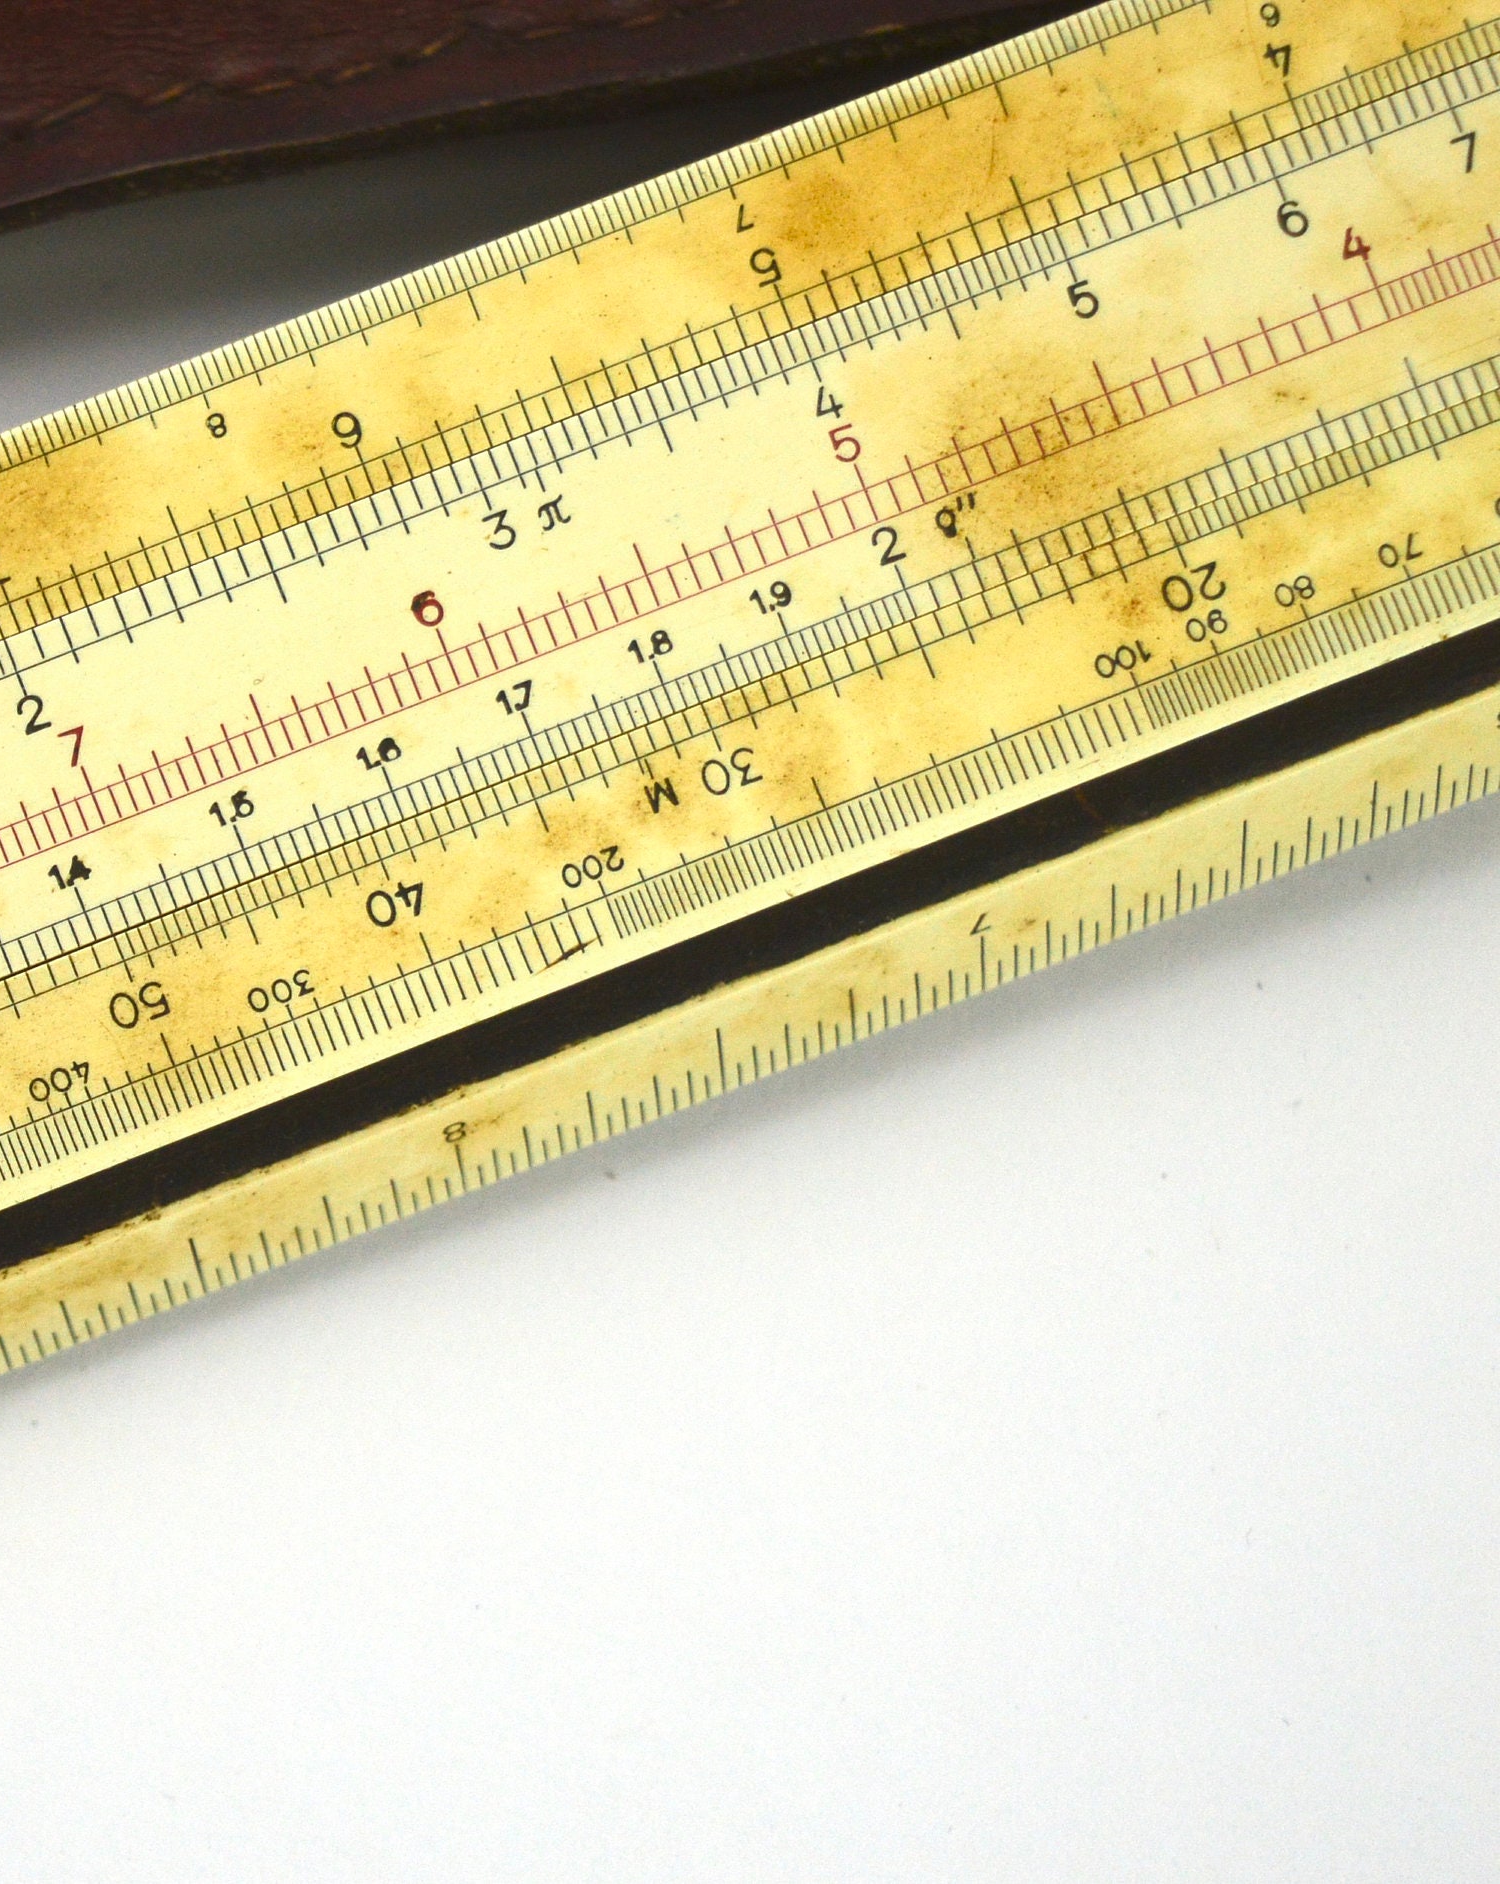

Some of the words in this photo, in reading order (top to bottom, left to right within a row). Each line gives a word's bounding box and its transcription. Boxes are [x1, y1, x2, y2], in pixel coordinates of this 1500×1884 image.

[1264, 42, 1292, 78] 4
[1450, 132, 1477, 173] 7
[735, 205, 756, 234] 7
[1276, 201, 1309, 237] 6
[1342, 227, 1371, 261] 4
[749, 247, 782, 286] 5
[1067, 281, 1099, 319] 5
[815, 385, 844, 420] 4
[207, 414, 227, 438] 8
[827, 425, 861, 463] 5
[482, 511, 516, 550] 3
[537, 497, 571, 530] π
[871, 526, 906, 565] 2
[1378, 531, 1424, 568] 70
[749, 581, 792, 614] 1.9
[1161, 561, 1227, 612] 20
[1274, 575, 1316, 607] 80
[411, 590, 444, 627] 6
[1186, 609, 1228, 642] 90
[627, 629, 674, 664] 1.8
[1094, 641, 1151, 679] 100
[17, 695, 51, 734] 2
[59, 726, 84, 767] 7
[701, 747, 762, 795] 30
[562, 846, 625, 889] 200
[366, 881, 425, 927] 40
[970, 912, 992, 936] 7
[110, 981, 171, 1029] 50
[248, 969, 314, 1012] 300
[29, 1060, 91, 1101] 400
[443, 1122, 467, 1144] 8
